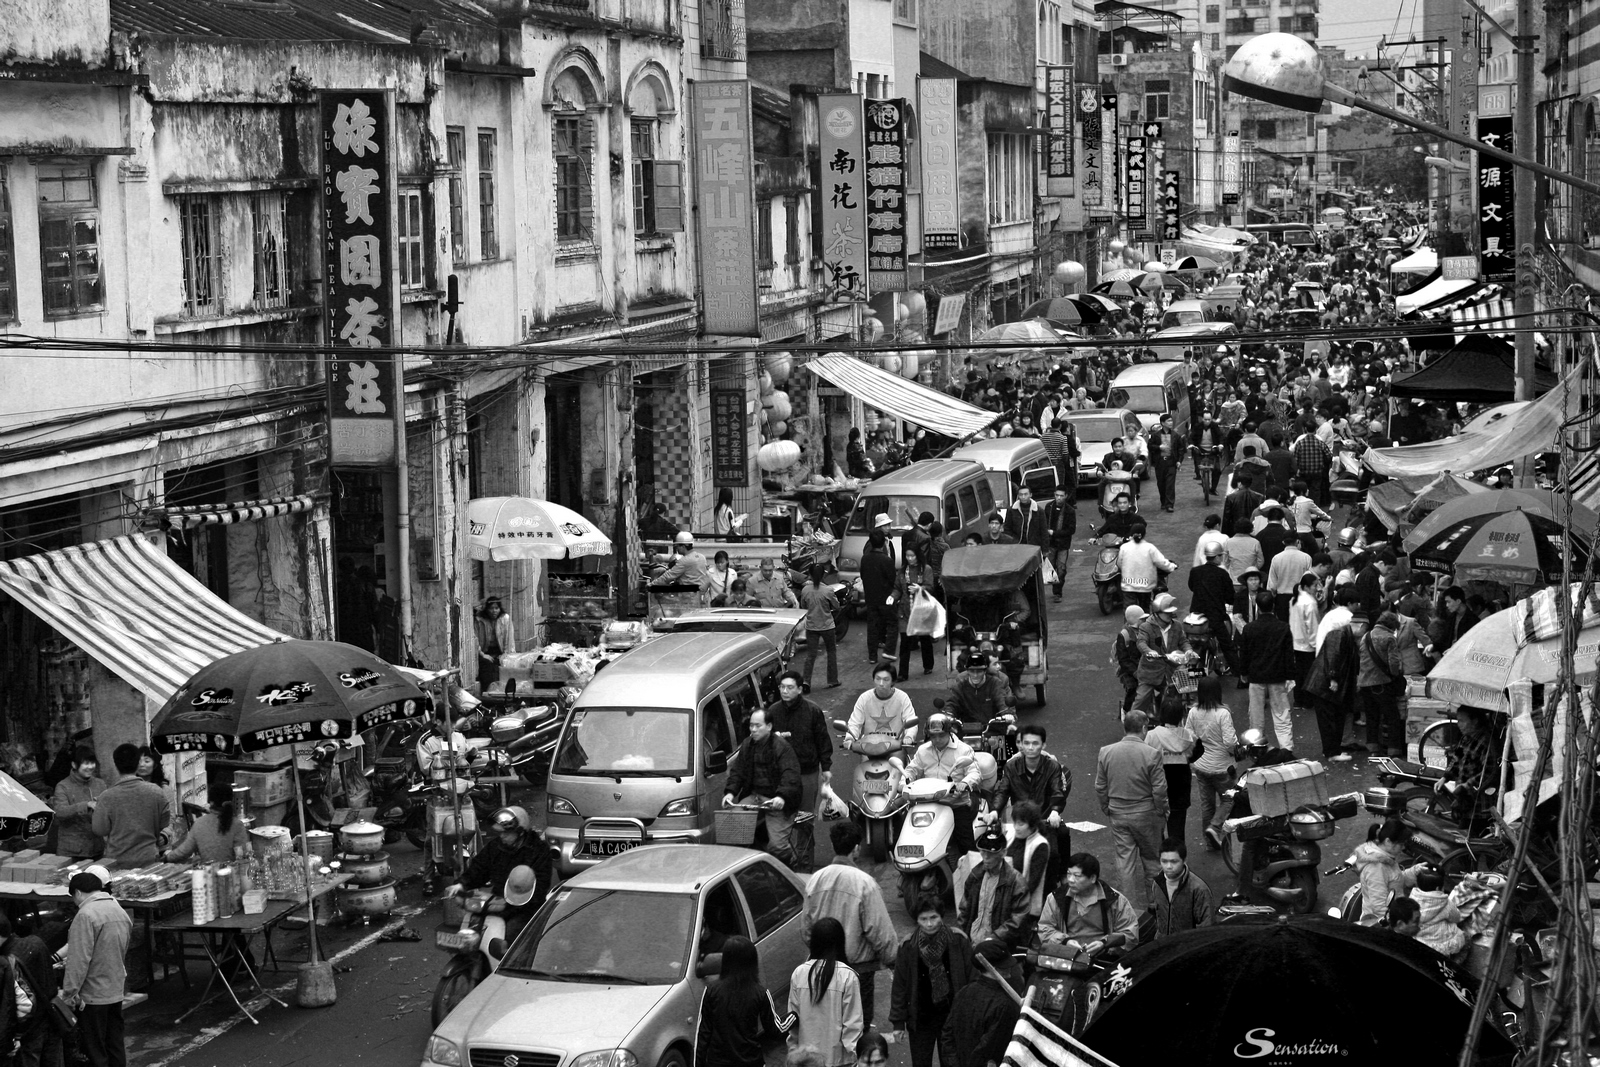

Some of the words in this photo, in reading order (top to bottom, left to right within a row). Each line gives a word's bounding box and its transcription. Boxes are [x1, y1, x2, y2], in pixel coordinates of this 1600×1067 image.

[323, 130, 331, 151] LU
[867, 144, 902, 254] 熊猫竹凉席
[325, 209, 335, 251] YUAN
[328, 264, 336, 295] TEA
[497, 531, 554, 539] 特效中药牙膏
[166, 732, 208, 744] 可口可乐公司
[255, 721, 312, 741] 可口可乐公司
[1233, 1027, 1339, 1059] Sensation
